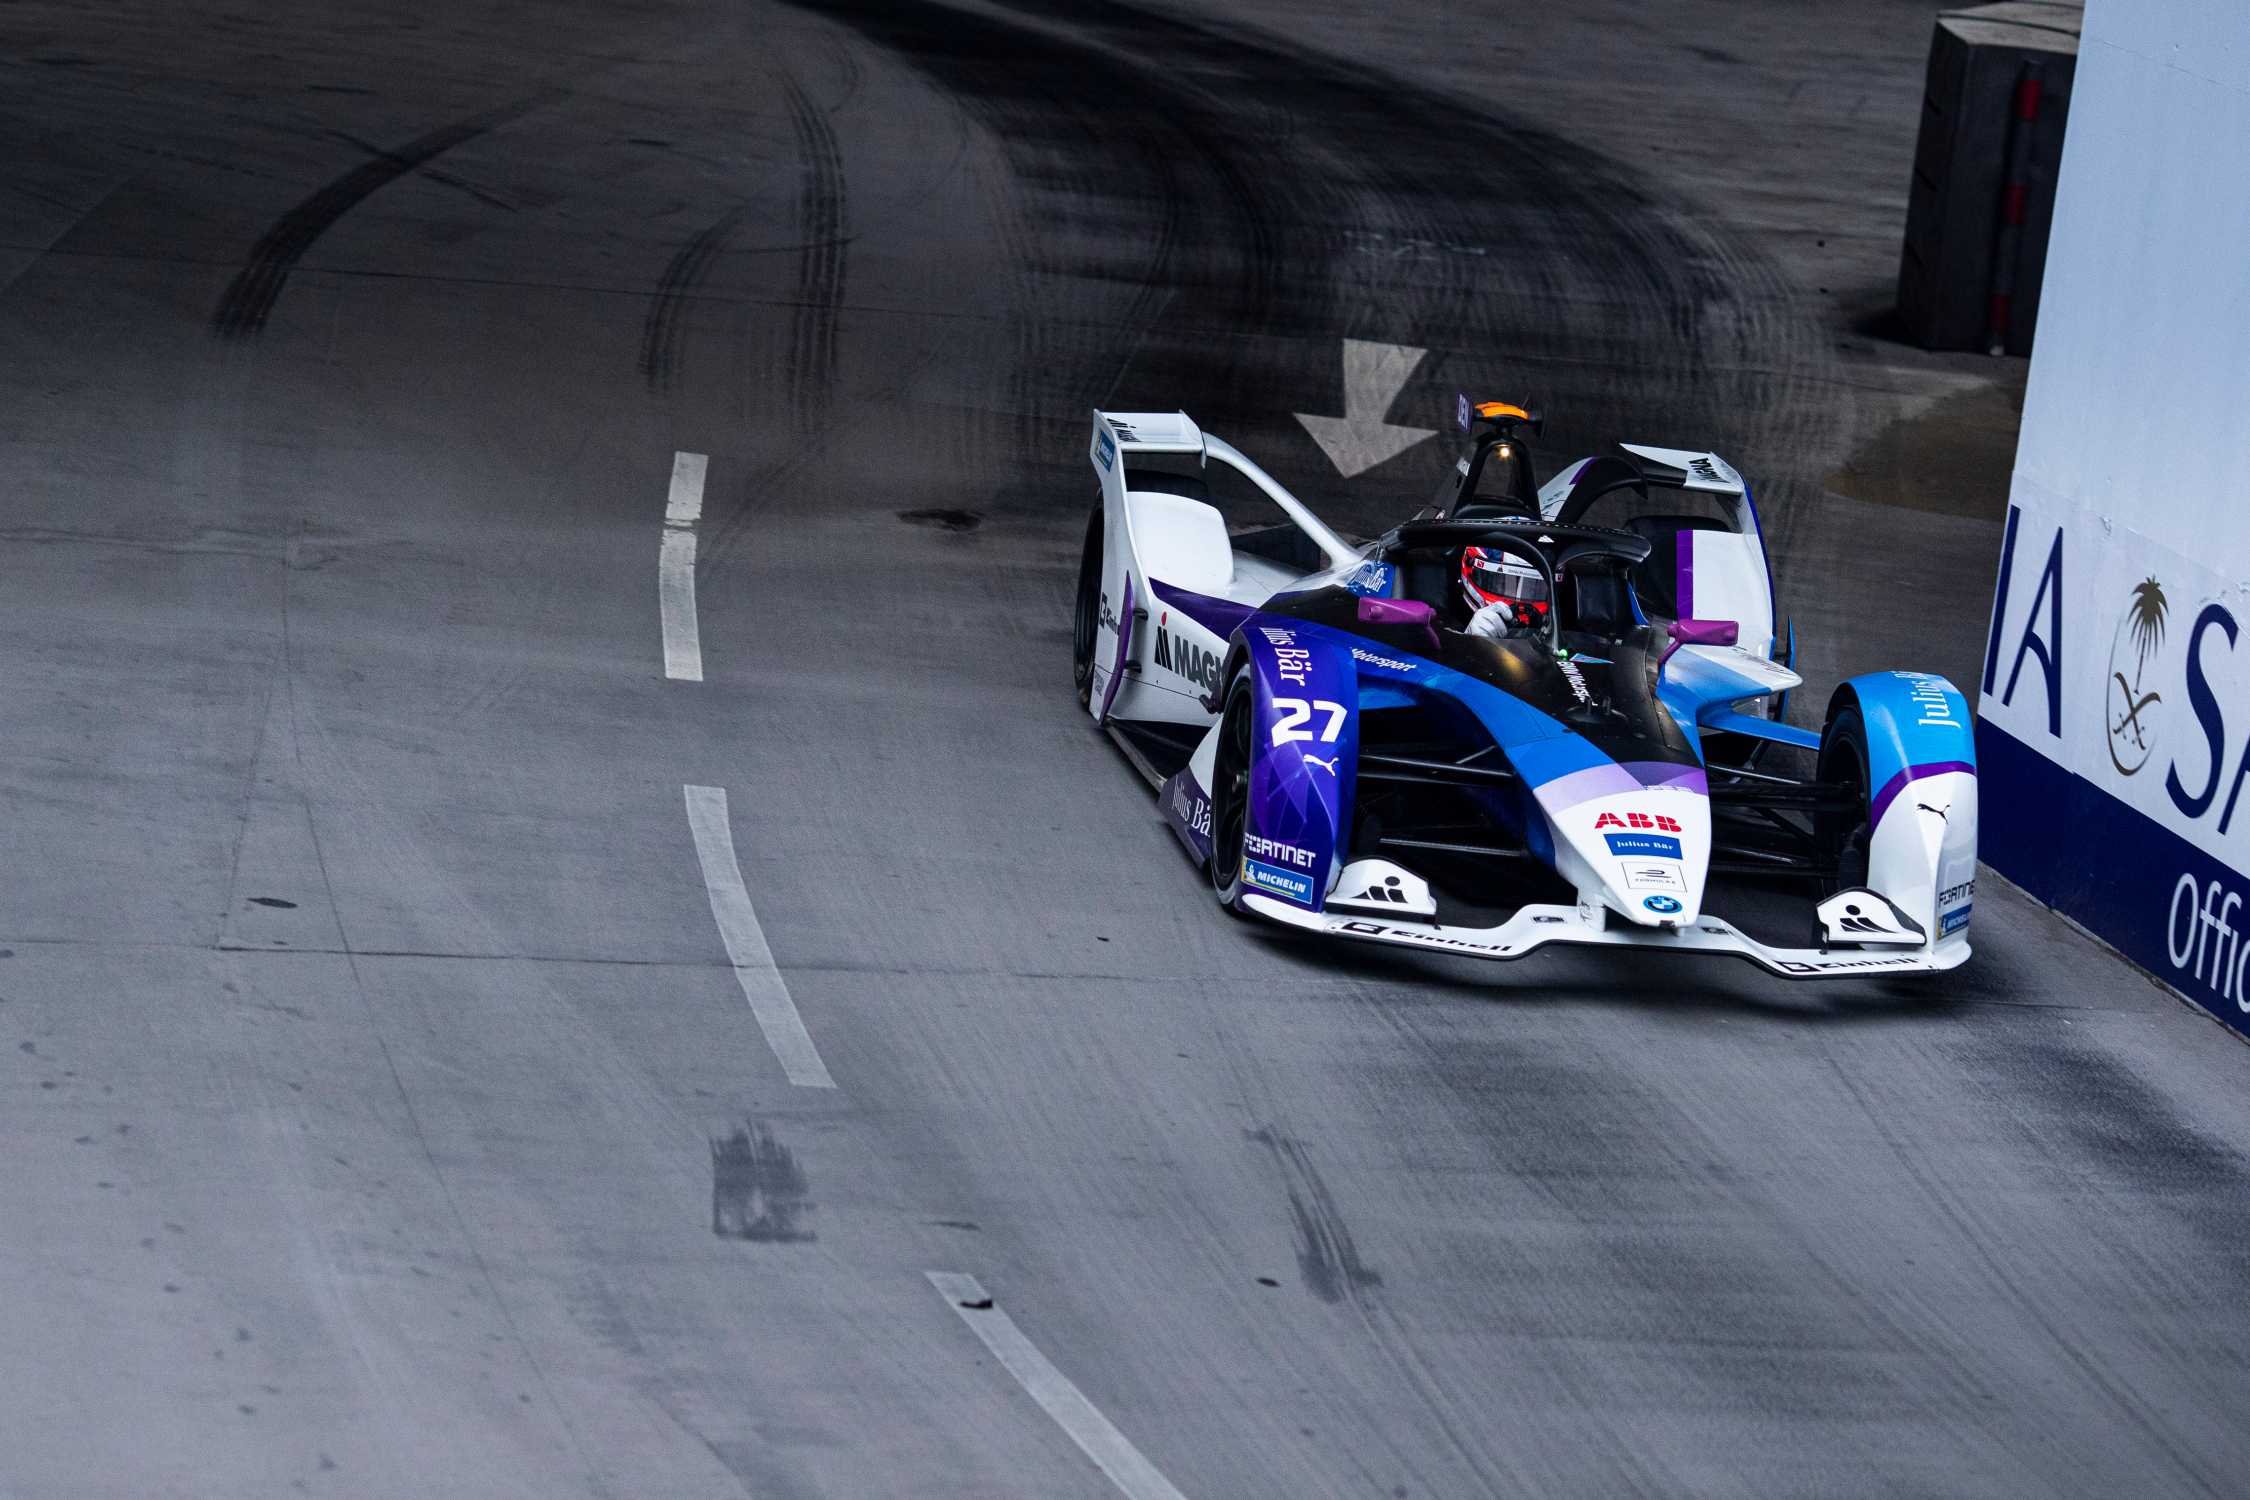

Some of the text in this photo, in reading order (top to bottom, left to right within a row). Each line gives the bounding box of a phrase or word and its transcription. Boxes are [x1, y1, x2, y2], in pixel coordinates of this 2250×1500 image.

[1274, 647, 1313, 687] Bär
[1271, 697, 1348, 748] 27
[1594, 812, 1683, 833] ABB
[1243, 831, 1316, 868] FORTINET
[1257, 871, 1307, 893] MICHELIN
[1938, 879, 1976, 908] FORTINE
